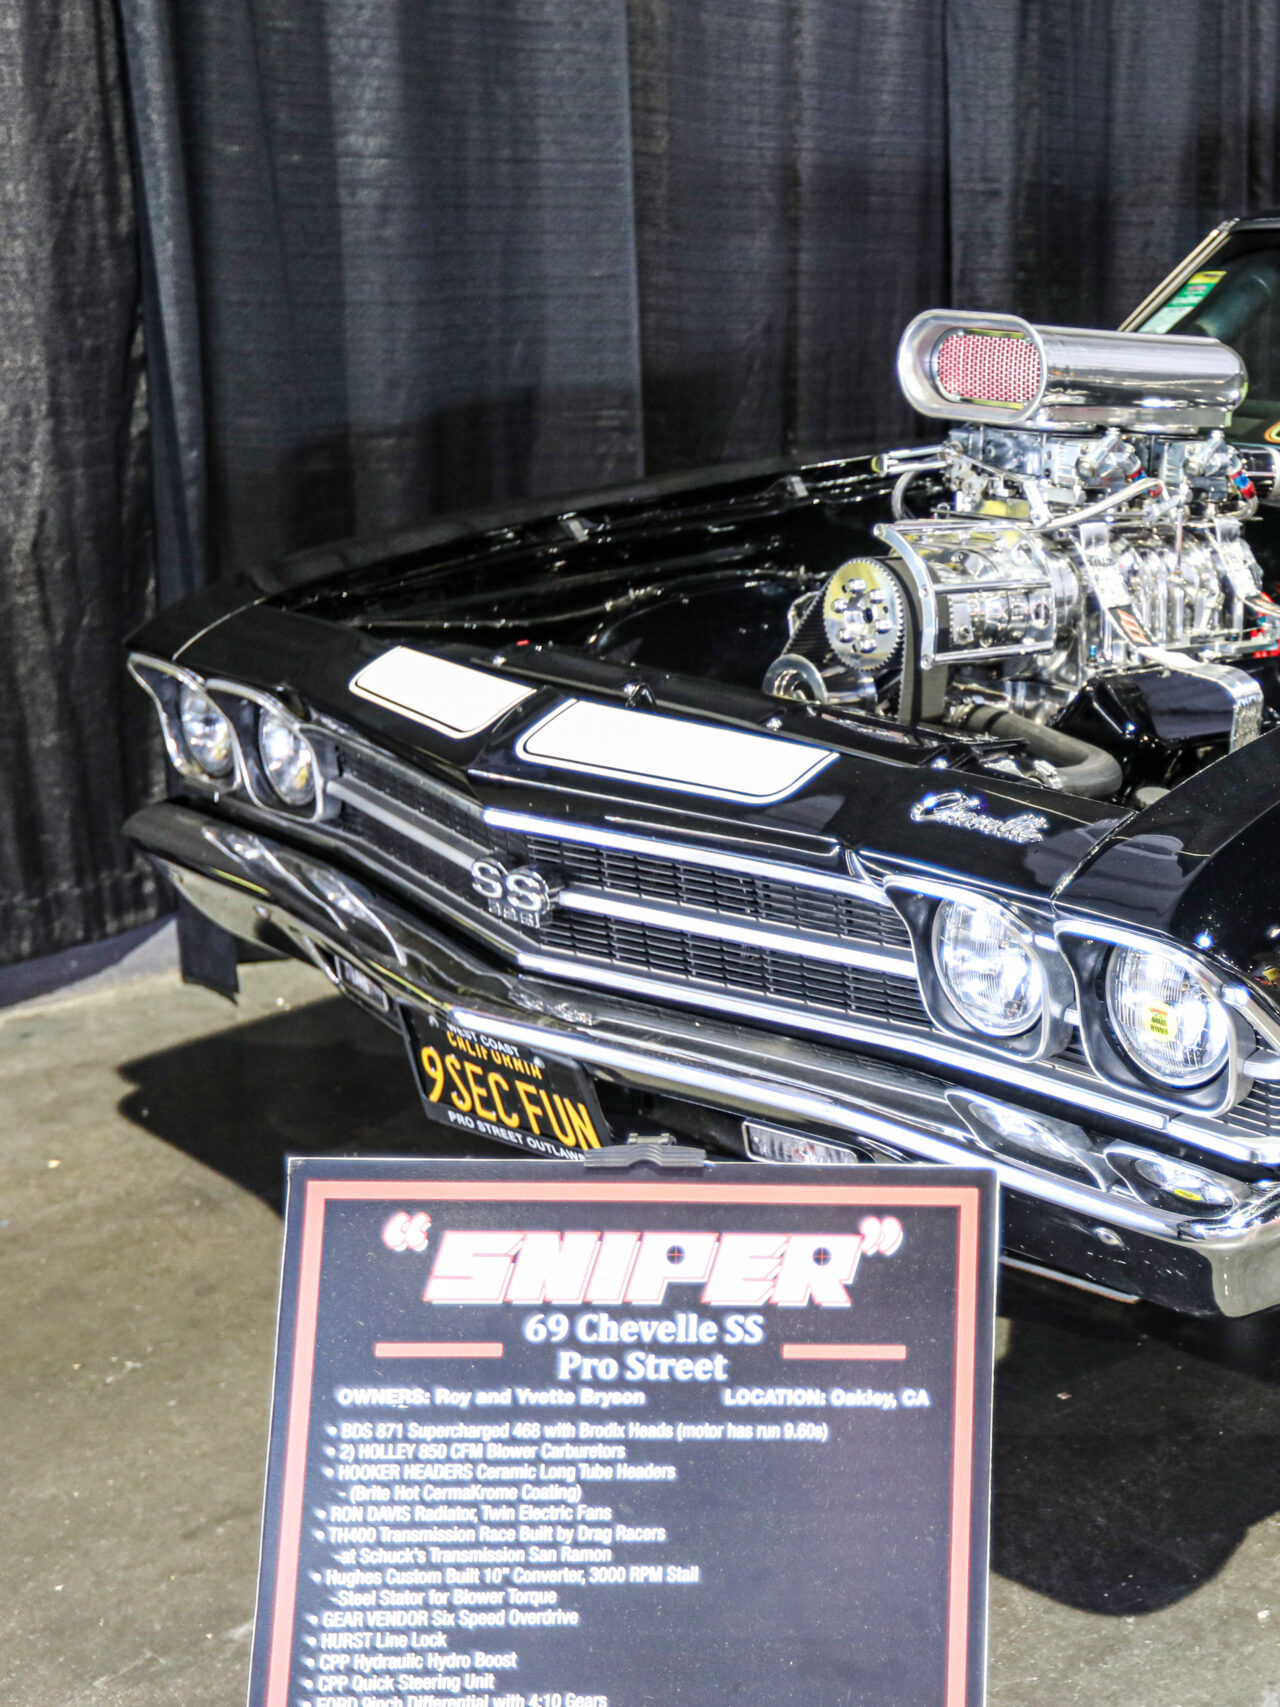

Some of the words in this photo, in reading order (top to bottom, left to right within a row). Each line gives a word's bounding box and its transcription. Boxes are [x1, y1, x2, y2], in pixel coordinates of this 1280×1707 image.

[910, 791, 1048, 844] Chevelle
[470, 858, 548, 912] SS
[480, 1034, 521, 1058] COAST
[447, 1110, 476, 1129] PRO
[477, 1119, 525, 1146] STREET
[524, 1313, 569, 1342] 69
[576, 1312, 718, 1343] Chevelle
[724, 1314, 764, 1344] SS
[558, 1351, 619, 1380] Pro
[625, 1351, 728, 1381] Street
[336, 1387, 431, 1406] OWNERS:
[435, 1387, 472, 1408] Roy
[475, 1388, 512, 1405] and
[515, 1387, 576, 1405] Yvette
[580, 1387, 646, 1408] Bryson
[724, 1388, 827, 1406] LOCATION:
[830, 1388, 897, 1409] Oakley,
[901, 1388, 930, 1407] CA
[340, 1422, 374, 1439] BDS
[375, 1422, 403, 1439] 871
[407, 1422, 510, 1442] Supercharged
[512, 1422, 541, 1439] 468
[543, 1422, 576, 1439] with
[579, 1421, 626, 1439] Brodix
[628, 1422, 674, 1439] Heads
[676, 1422, 725, 1442] (motor
[727, 1422, 754, 1439] has
[756, 1425, 781, 1439] run
[339, 1443, 356, 1463] 2)
[358, 1442, 417, 1460] HOLLEY
[418, 1443, 448, 1460] 850
[450, 1442, 484, 1460] CFM
[486, 1442, 539, 1459] Blower
[540, 1442, 626, 1460] Carburetors
[338, 1463, 401, 1481] HOOKER
[403, 1463, 474, 1480] HEADERS
[476, 1463, 537, 1480] Ceramic
[539, 1463, 577, 1483] Long
[578, 1462, 614, 1480] Tube
[616, 1462, 676, 1480] Headers
[393, 1484, 421, 1501] Hot
[521, 1483, 582, 1503] Coating)
[330, 1505, 364, 1523] RON
[366, 1505, 412, 1522] DAVIS
[414, 1504, 479, 1523] Radiator,
[481, 1504, 516, 1521] Twin
[518, 1504, 574, 1521] Electric
[576, 1504, 613, 1521] Fans
[328, 1526, 377, 1544] TH400
[379, 1525, 476, 1543] Transmission
[479, 1525, 517, 1542] Race
[519, 1525, 554, 1542] Built
[556, 1525, 575, 1546] by
[577, 1524, 613, 1545] Drag
[615, 1524, 666, 1541] Racers
[429, 1546, 526, 1563] Transmission
[528, 1545, 558, 1563] San
[560, 1545, 612, 1562] Ramon
[325, 1568, 383, 1589] Hughes
[385, 1567, 443, 1585] Custom
[445, 1567, 481, 1584] Built
[512, 1566, 586, 1587] Converter,
[588, 1566, 627, 1583] 3000
[629, 1565, 664, 1583] RPM
[666, 1565, 700, 1583] Stall
[379, 1588, 426, 1606] Stator
[428, 1588, 451, 1605] for
[452, 1588, 506, 1605] Blower
[507, 1587, 558, 1609] Torque
[322, 1610, 364, 1628] GEAR
[366, 1609, 429, 1628] VENDOR
[431, 1609, 456, 1627] Six
[458, 1609, 506, 1629] Speed
[508, 1608, 579, 1626] Overdrive
[320, 1631, 374, 1649] HURST
[375, 1631, 409, 1649] Line
[411, 1631, 448, 1648] Lock
[319, 1653, 351, 1671] CPP
[353, 1652, 424, 1674] Hydraulic
[427, 1652, 471, 1674] Hydro
[473, 1651, 518, 1669] Boost
[317, 1674, 350, 1693] CPP
[351, 1674, 395, 1693] Quick
[397, 1673, 461, 1694] Steering
[464, 1672, 495, 1691] Unit
[406, 1694, 489, 1707] Differential
[492, 1693, 526, 1707] with
[565, 1692, 608, 1707] Gears
